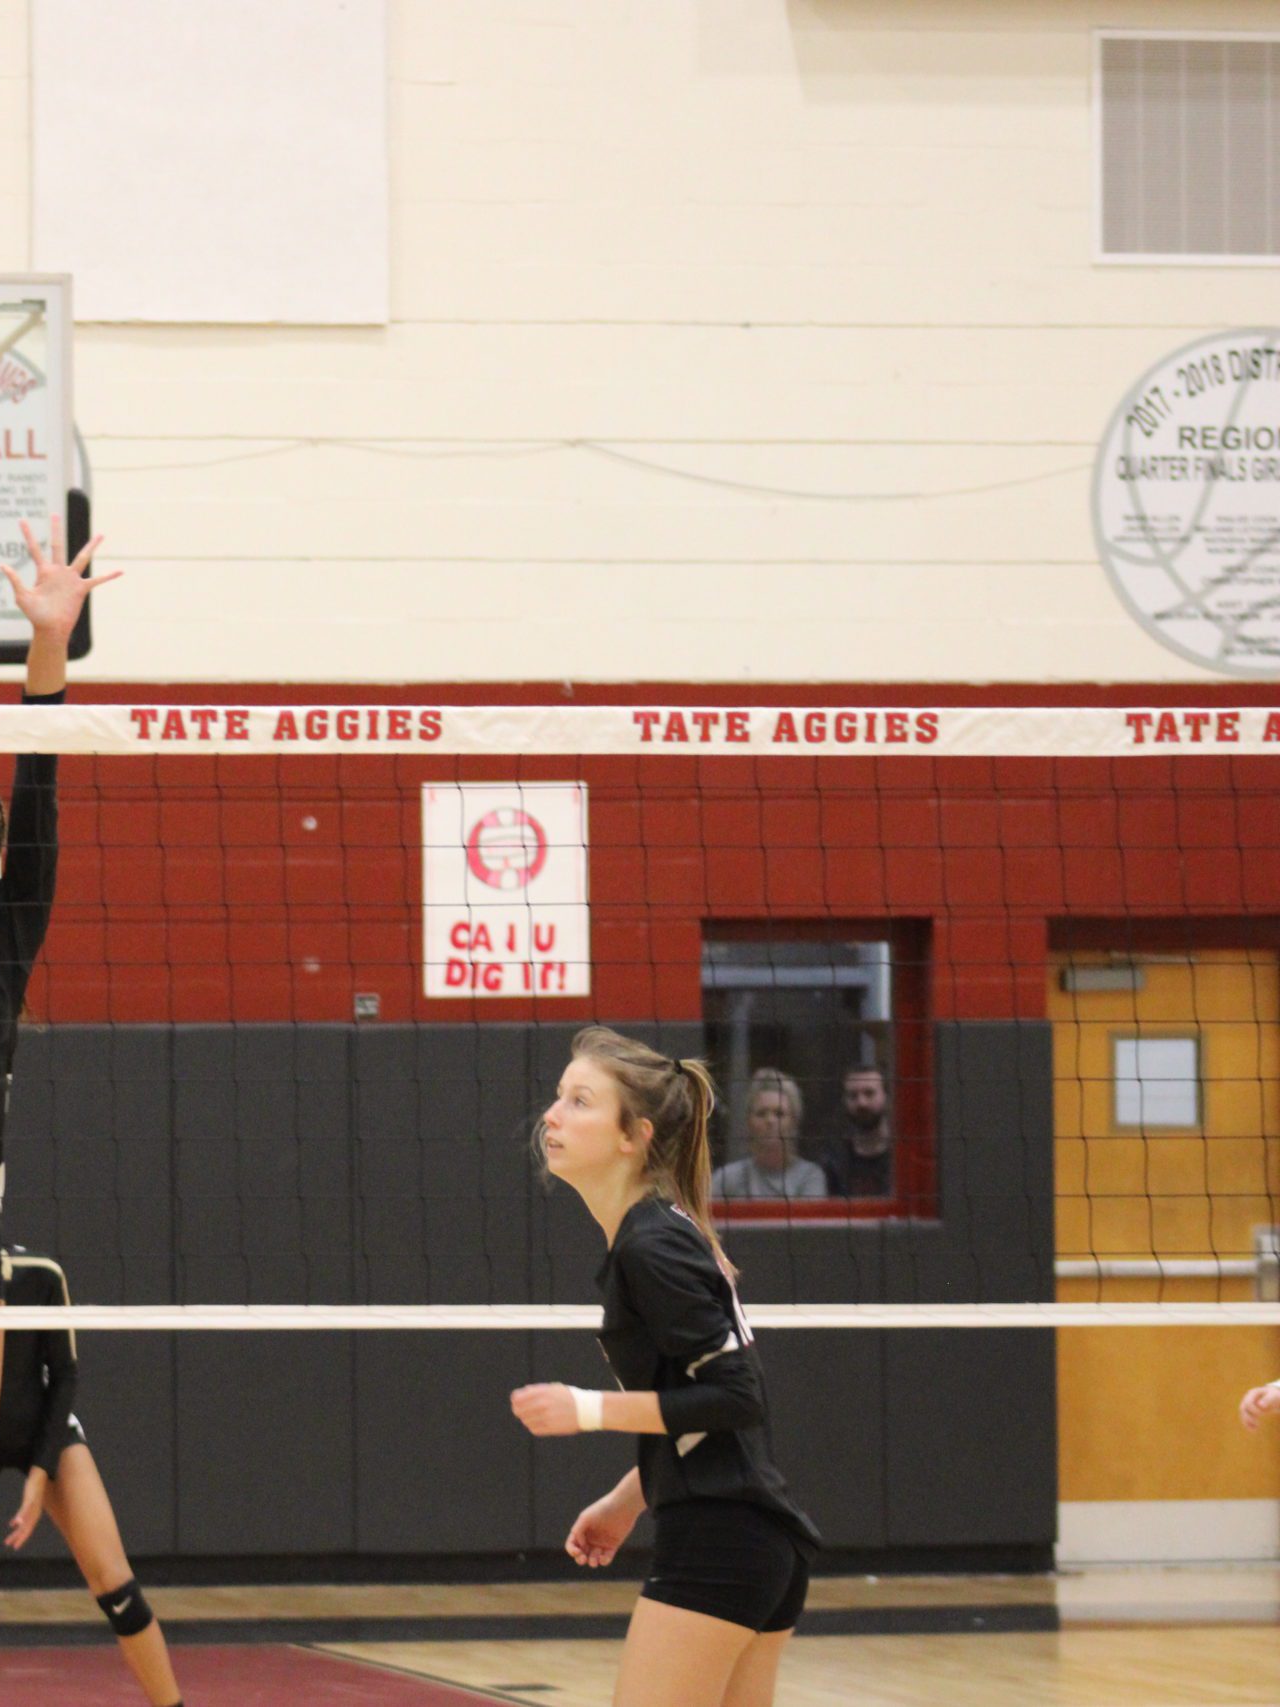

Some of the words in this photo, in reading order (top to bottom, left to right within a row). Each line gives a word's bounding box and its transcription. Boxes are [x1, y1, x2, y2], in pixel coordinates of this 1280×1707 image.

[1126, 386, 1173, 438] 2017
[1177, 353, 1225, 398] 2018
[1179, 426, 1280, 450] REGIO
[131, 709, 250, 742] TATE
[273, 709, 443, 742] AGGIES
[633, 712, 751, 743] TATE
[772, 712, 939, 743] AGGIES
[1126, 712, 1240, 743] TATE
[445, 958, 503, 991] DIG
